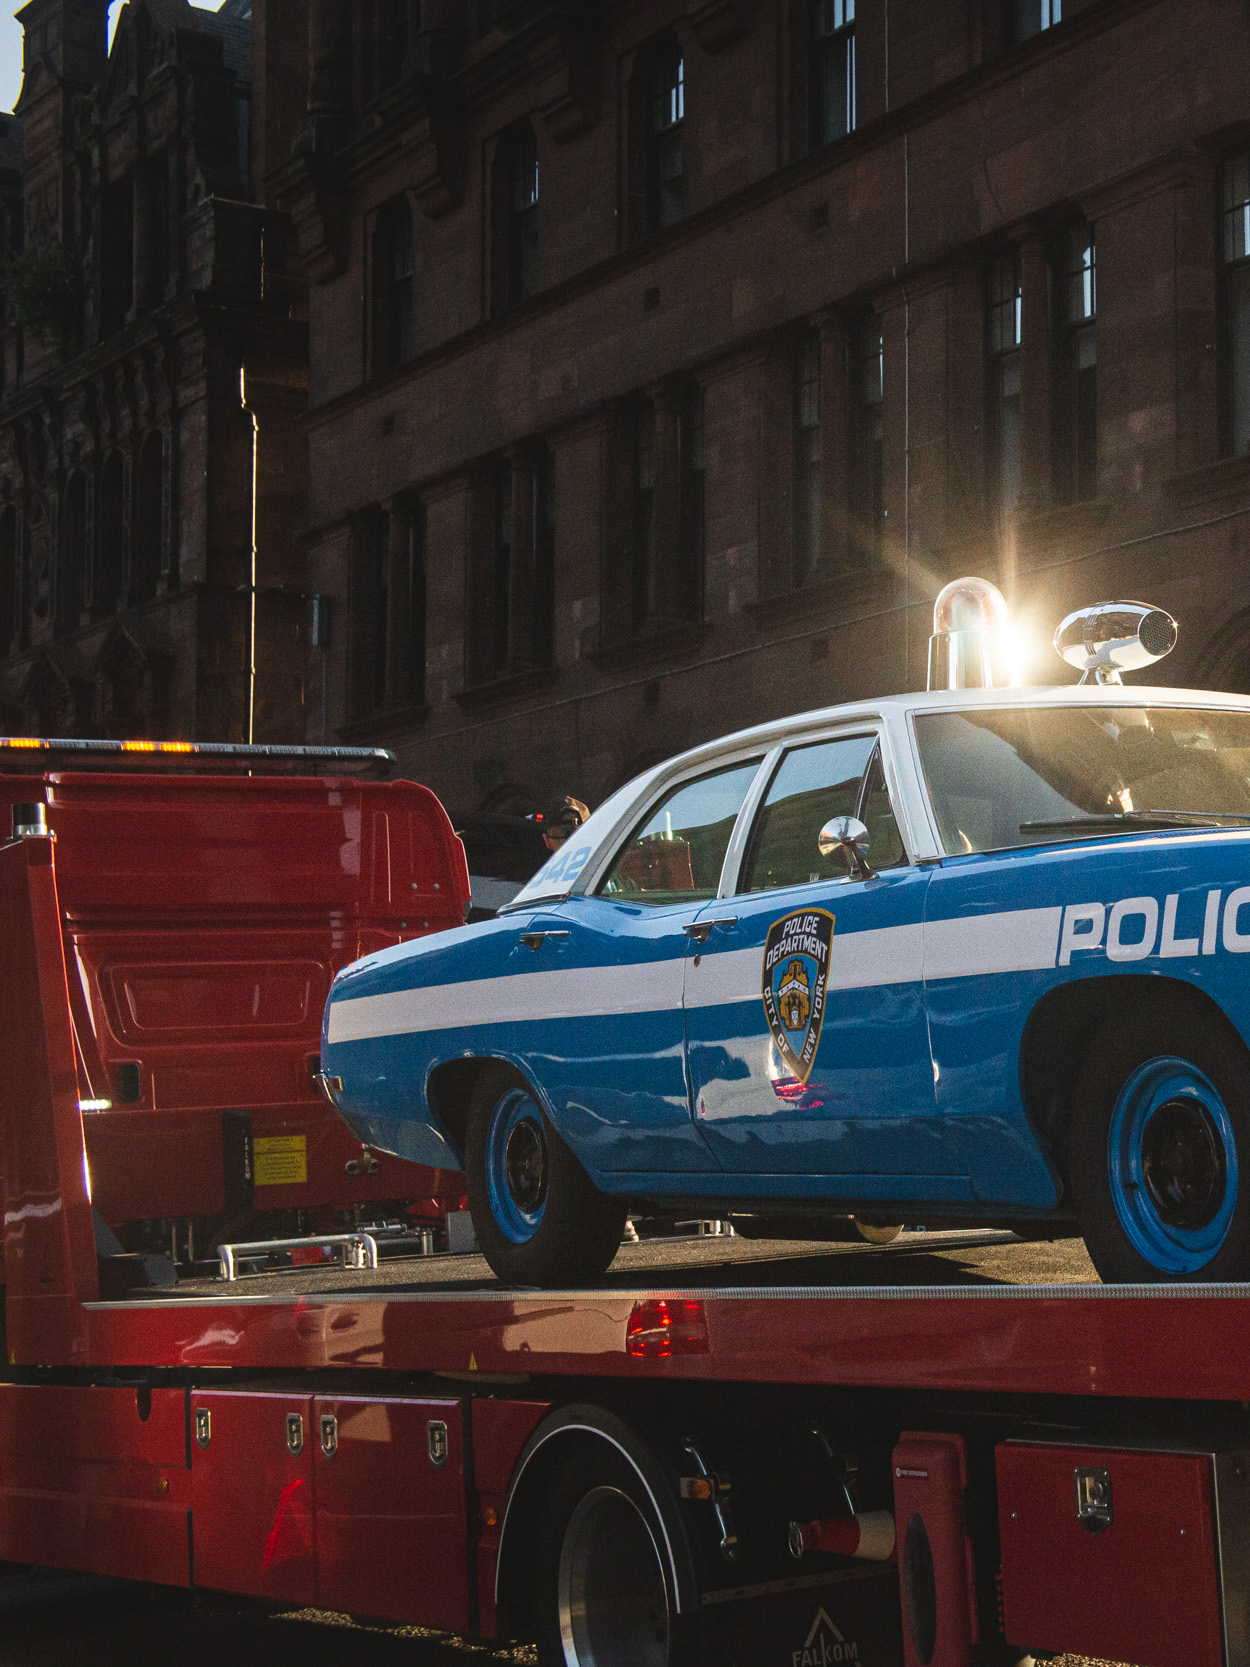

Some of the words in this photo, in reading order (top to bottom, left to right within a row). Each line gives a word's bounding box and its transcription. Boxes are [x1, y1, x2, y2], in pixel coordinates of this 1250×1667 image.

[782, 915, 820, 938] POLICE
[766, 935, 828, 971] DEPARTMENT
[764, 986, 778, 1027] CITY
[777, 1033, 790, 1053] OF
[803, 1027, 816, 1064] NEW
[813, 973, 826, 1020] YORK
[792, 1641, 858, 1667] FALKOM
